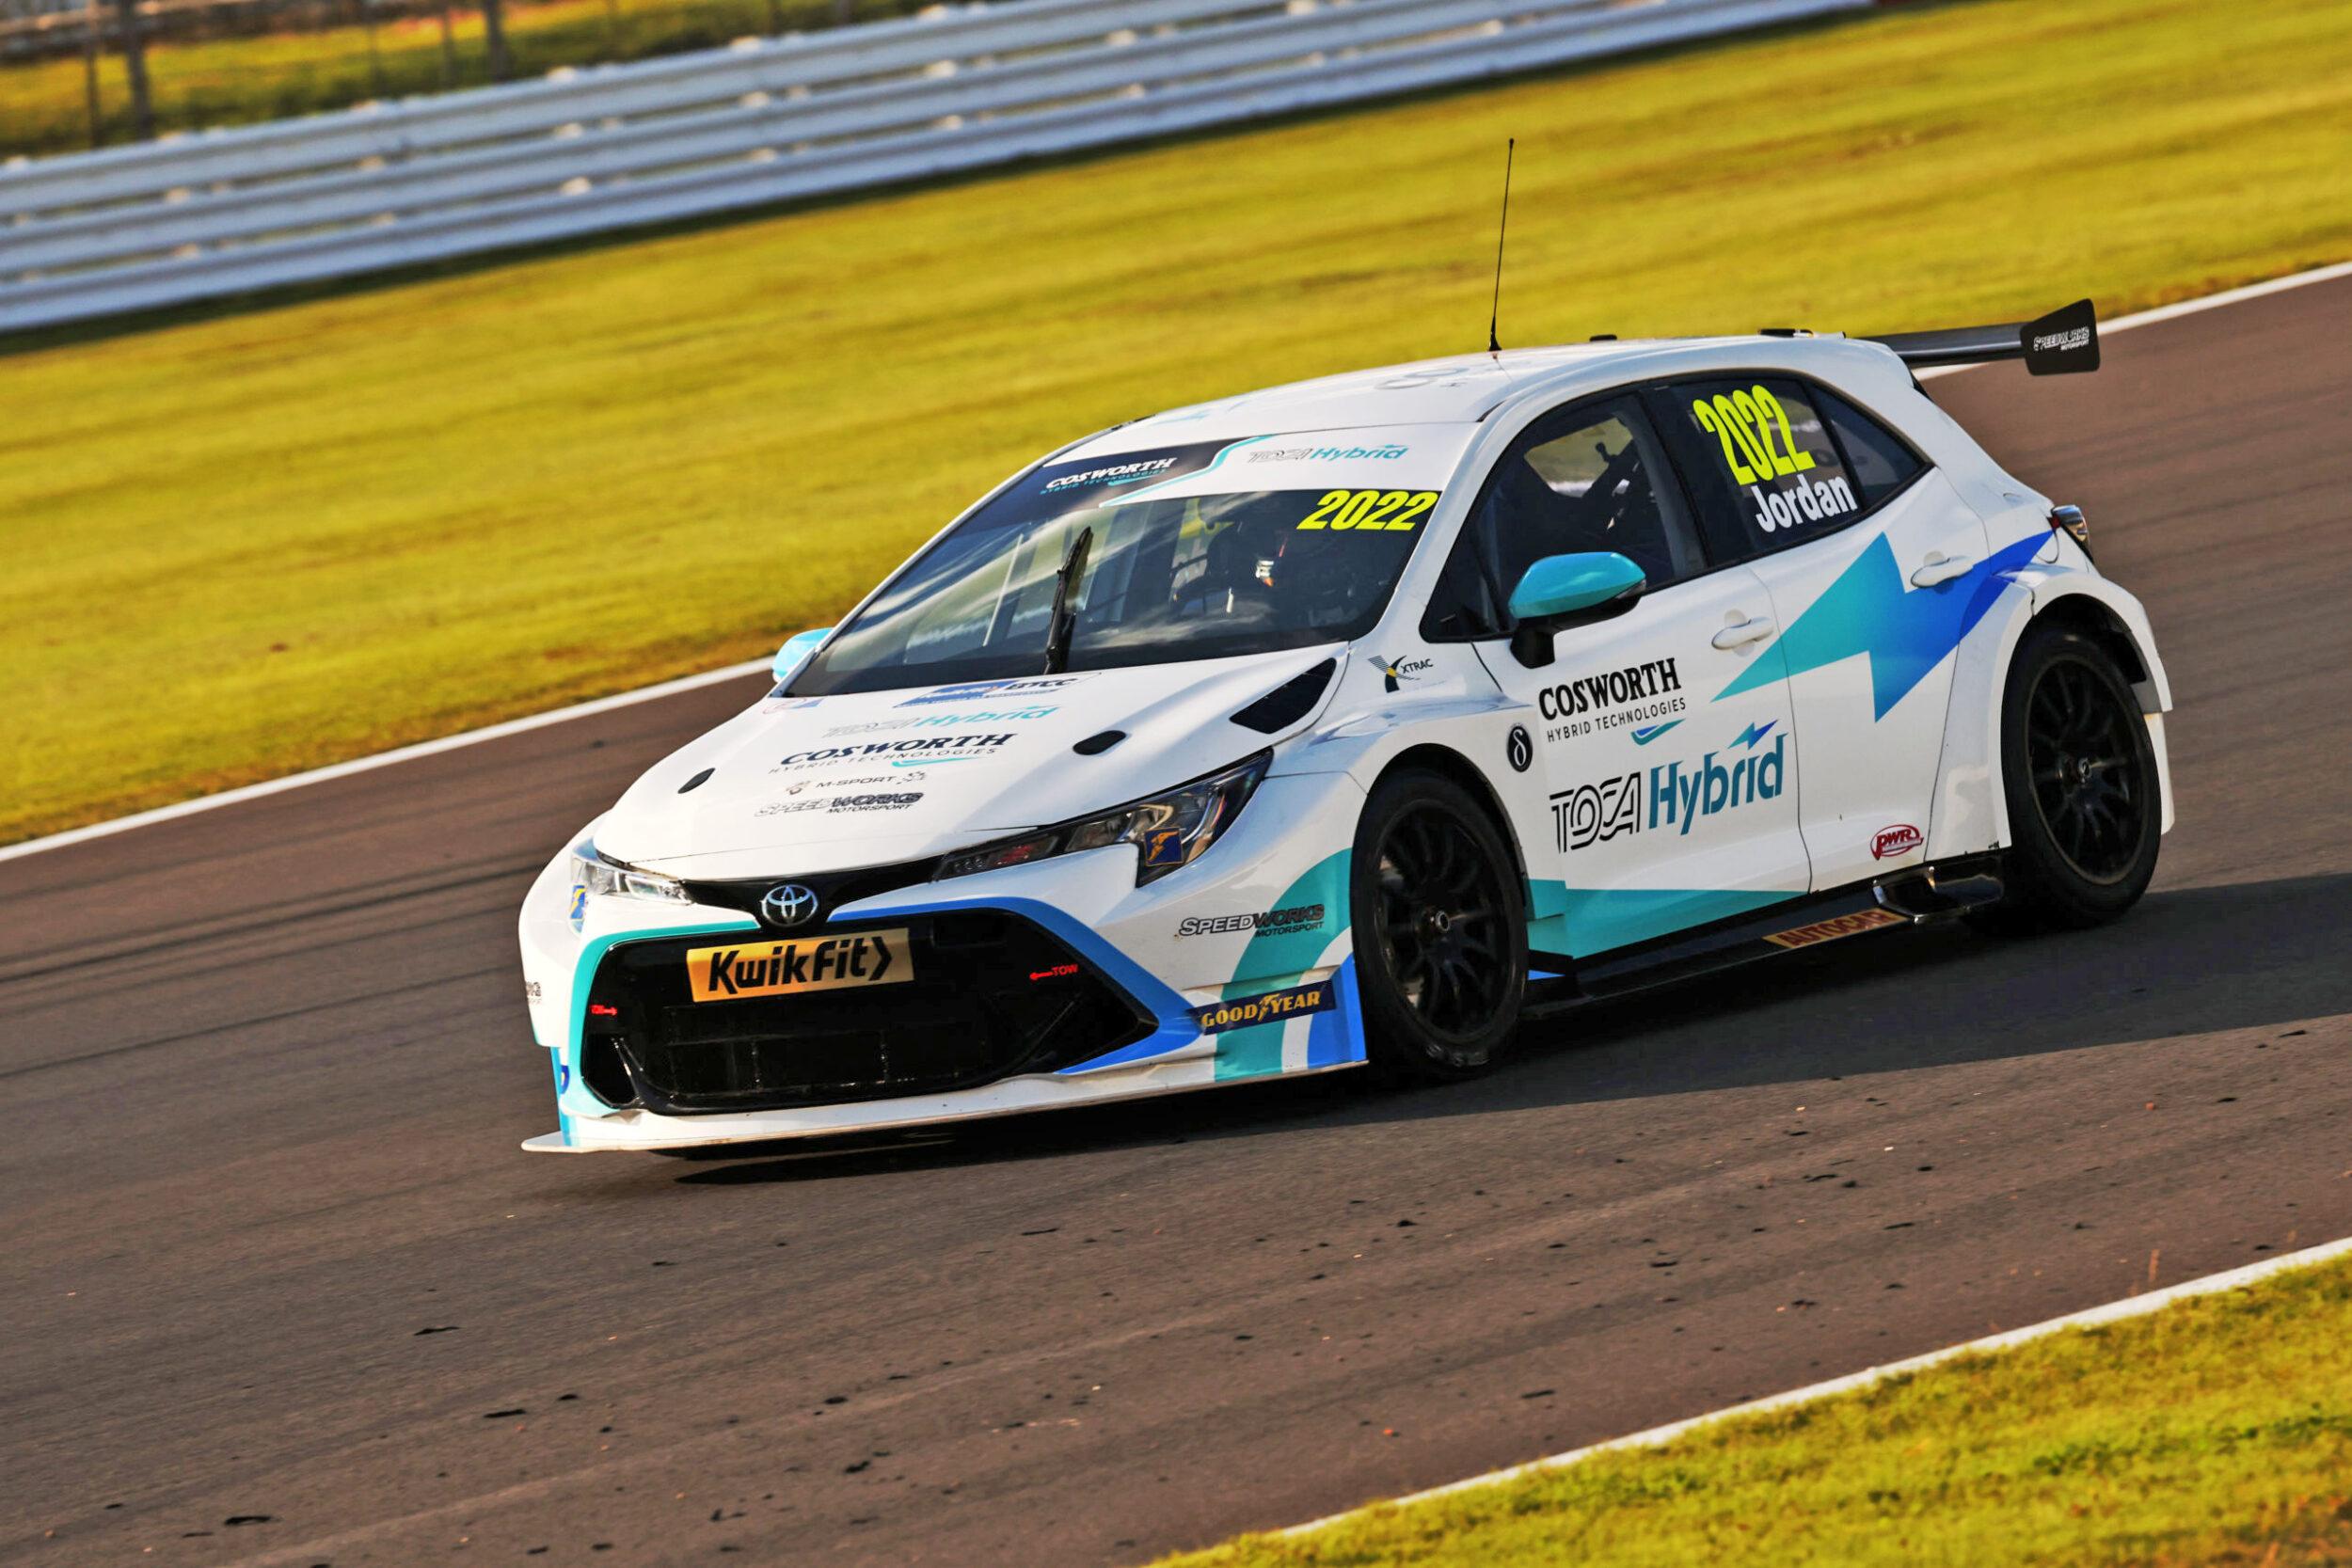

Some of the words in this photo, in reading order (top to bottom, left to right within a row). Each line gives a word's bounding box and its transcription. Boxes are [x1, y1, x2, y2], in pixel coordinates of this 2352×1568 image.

[1692, 385, 1817, 486] 2022
[1310, 446, 1409, 461] Hybrid
[1046, 458, 1177, 488] COSWORTH
[1296, 490, 1439, 531] 2022
[1751, 473, 1858, 533] Jordan
[1400, 658, 1434, 673] XTRAC
[1538, 657, 1682, 721] COSWORTH
[913, 706, 1060, 727] Hybrid
[1547, 721, 1591, 743] HYBRID
[1596, 697, 1686, 731] TECHNOLOGIES
[769, 759, 839, 774] HYBRID
[847, 748, 996, 764] TECHNOLOGIES
[781, 734, 1018, 766] COSWORTH
[816, 776, 897, 788] M-SPORT
[1549, 771, 1641, 854] TOCA
[1648, 732, 1788, 835] Hybrid
[826, 803, 912, 815] MOTORSPORT
[1255, 922, 1325, 938] MOTORSPORT
[1052, 964, 1078, 976] TOW
